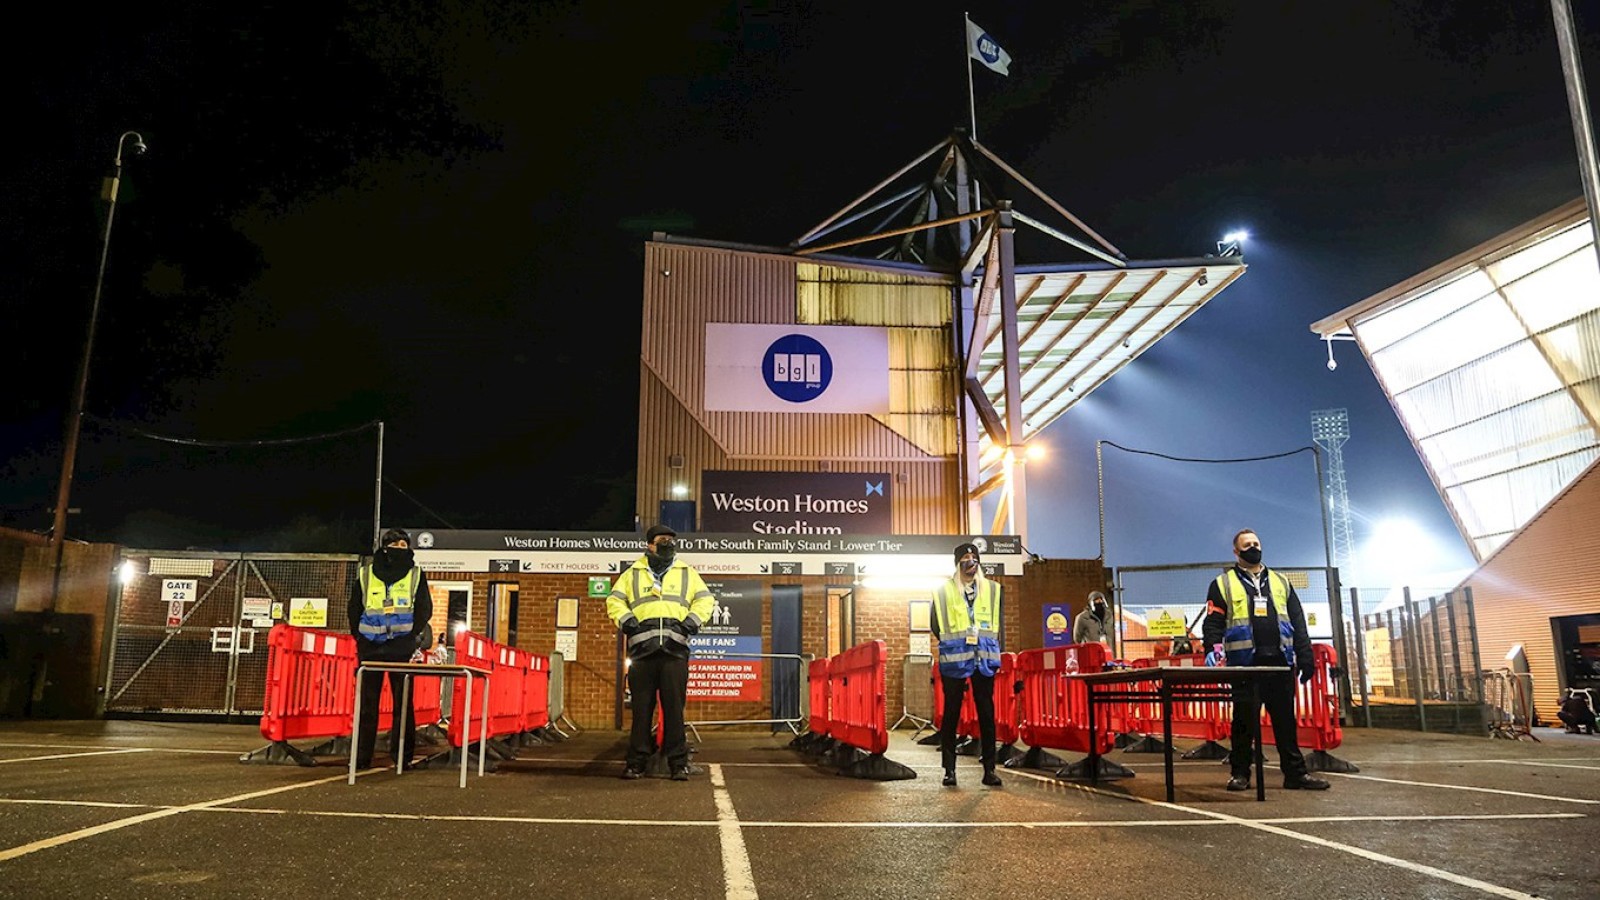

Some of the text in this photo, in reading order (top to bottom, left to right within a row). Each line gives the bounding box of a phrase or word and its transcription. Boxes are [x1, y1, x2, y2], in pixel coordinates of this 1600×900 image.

[711, 493, 868, 514] Weston Homes
[752, 520, 841, 534] Stadium
[504, 536, 547, 549] Weston
[549, 537, 591, 549] Homes
[677, 538, 694, 550] To
[695, 538, 719, 550] The
[720, 539, 756, 550] South
[757, 539, 794, 553] Family
[797, 539, 831, 550] Stand
[840, 540, 876, 551] Lower
[877, 540, 903, 551] Tier
[499, 563, 509, 572] 24
[540, 562, 600, 570] TICKET HOLDERS
[782, 566, 792, 574] 26
[834, 566, 845, 574] 27
[166, 581, 193, 590] GATE
[172, 591, 186, 600] 22
[690, 638, 736, 646] OME FANS
